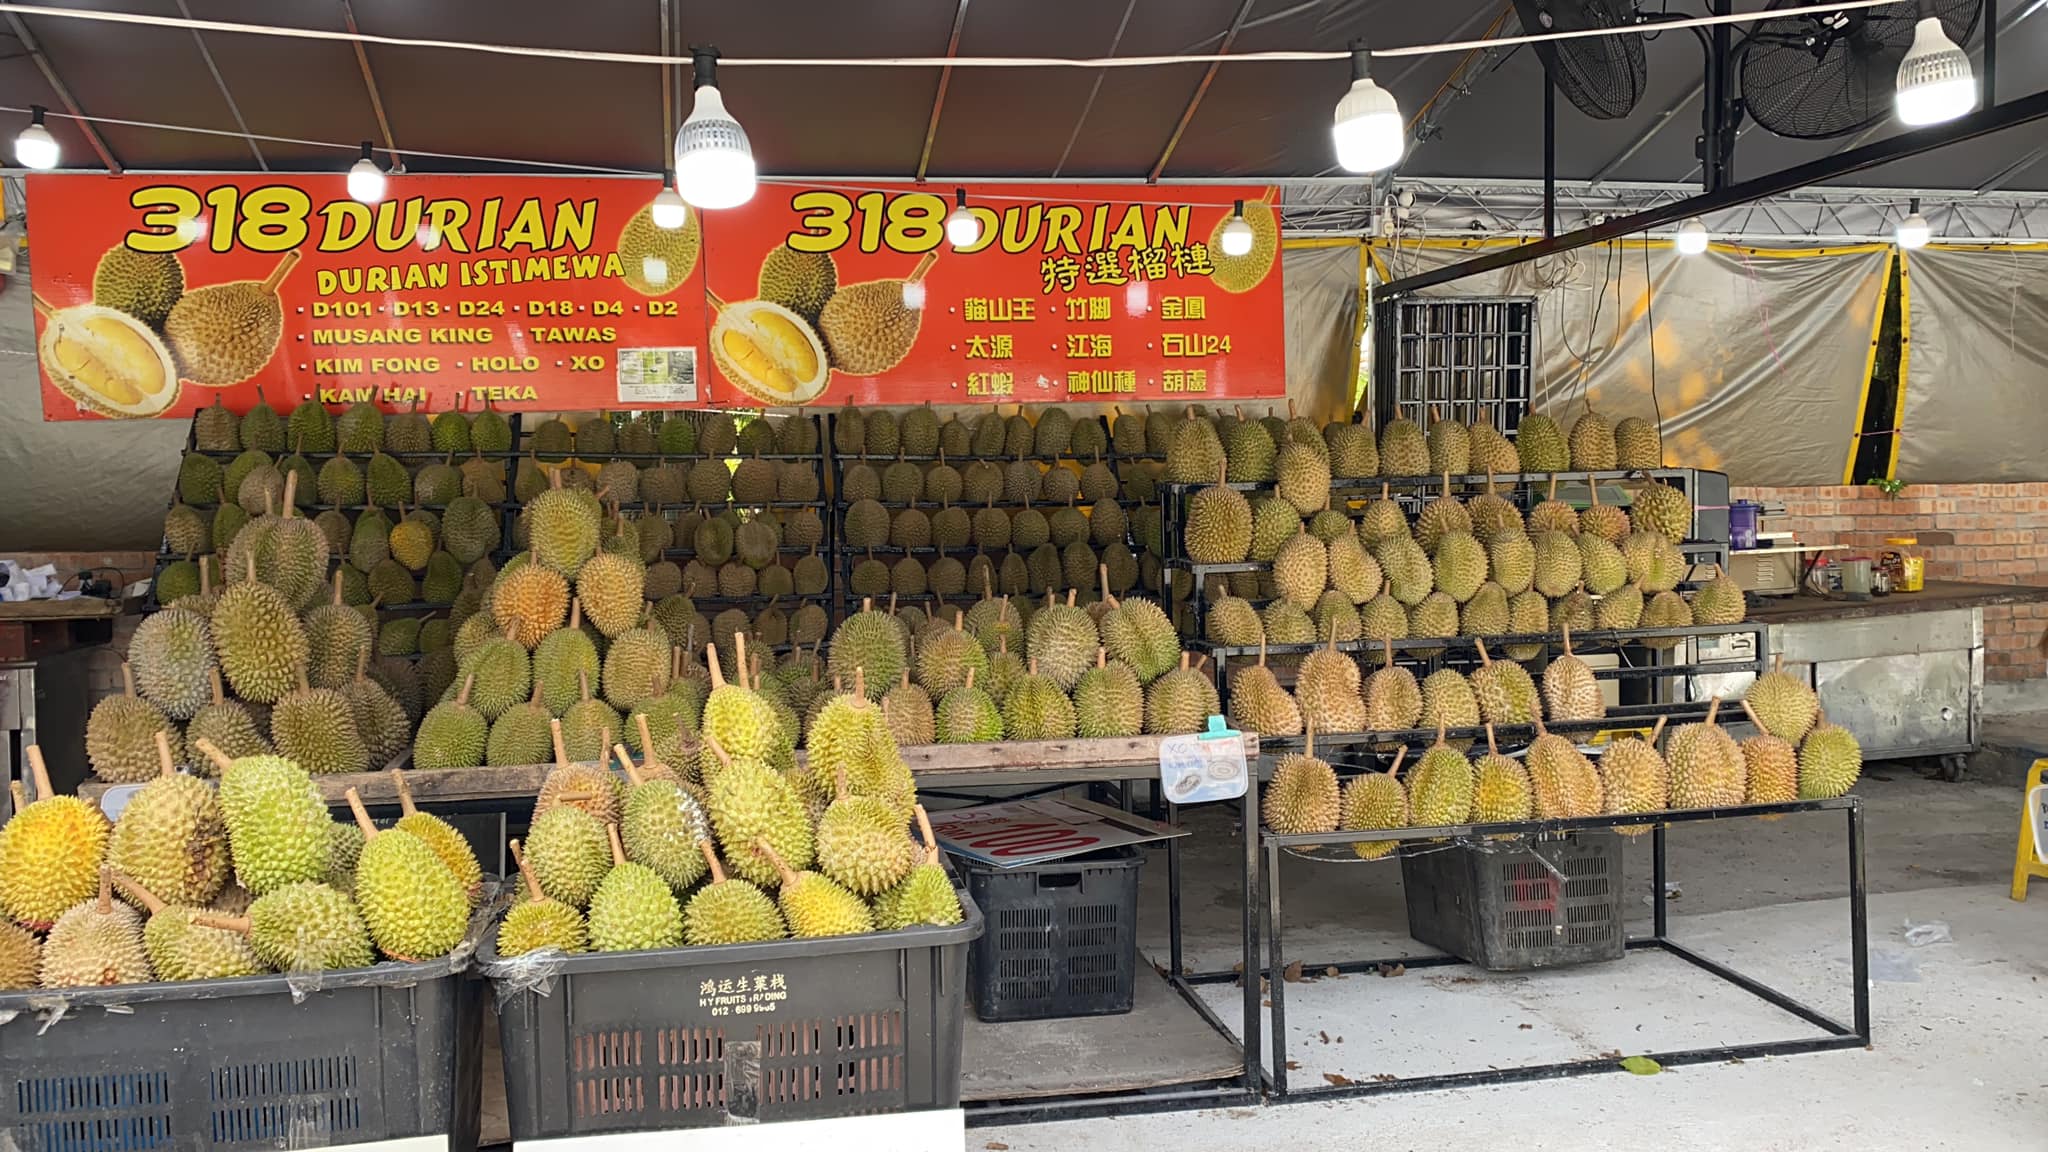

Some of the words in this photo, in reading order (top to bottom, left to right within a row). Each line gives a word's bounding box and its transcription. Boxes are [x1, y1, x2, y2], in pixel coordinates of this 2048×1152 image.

[125, 184, 312, 253] 318
[317, 196, 599, 252] DURIAN
[786, 190, 948, 253] 318
[316, 263, 449, 296] DURIAN
[460, 252, 626, 287] ISTIMEWA
[1041, 242, 1215, 294] 特選榴槤
[313, 301, 372, 317] D101
[393, 301, 441, 316] D13
[459, 301, 505, 316] D24
[528, 301, 574, 315] D18
[593, 301, 624, 315] D4
[648, 301, 678, 315] D2
[963, 297, 1036, 321] 貓山王
[313, 328, 423, 344] MUSANG
[430, 327, 494, 343] KING
[530, 327, 617, 342] TAWAS
[965, 334, 1013, 358] 太源
[1066, 334, 1113, 358] 江海
[315, 358, 363, 374] KIM
[371, 356, 441, 373] FONG
[472, 355, 540, 371] HOLO
[571, 355, 605, 370] XO
[472, 386, 538, 400] TEKA
[967, 371, 1014, 396] 紅蝦
[1067, 369, 1137, 394] 神仙種
[1162, 368, 1207, 393] 葫蘆
[715, 994, 747, 1006] FRUITS
